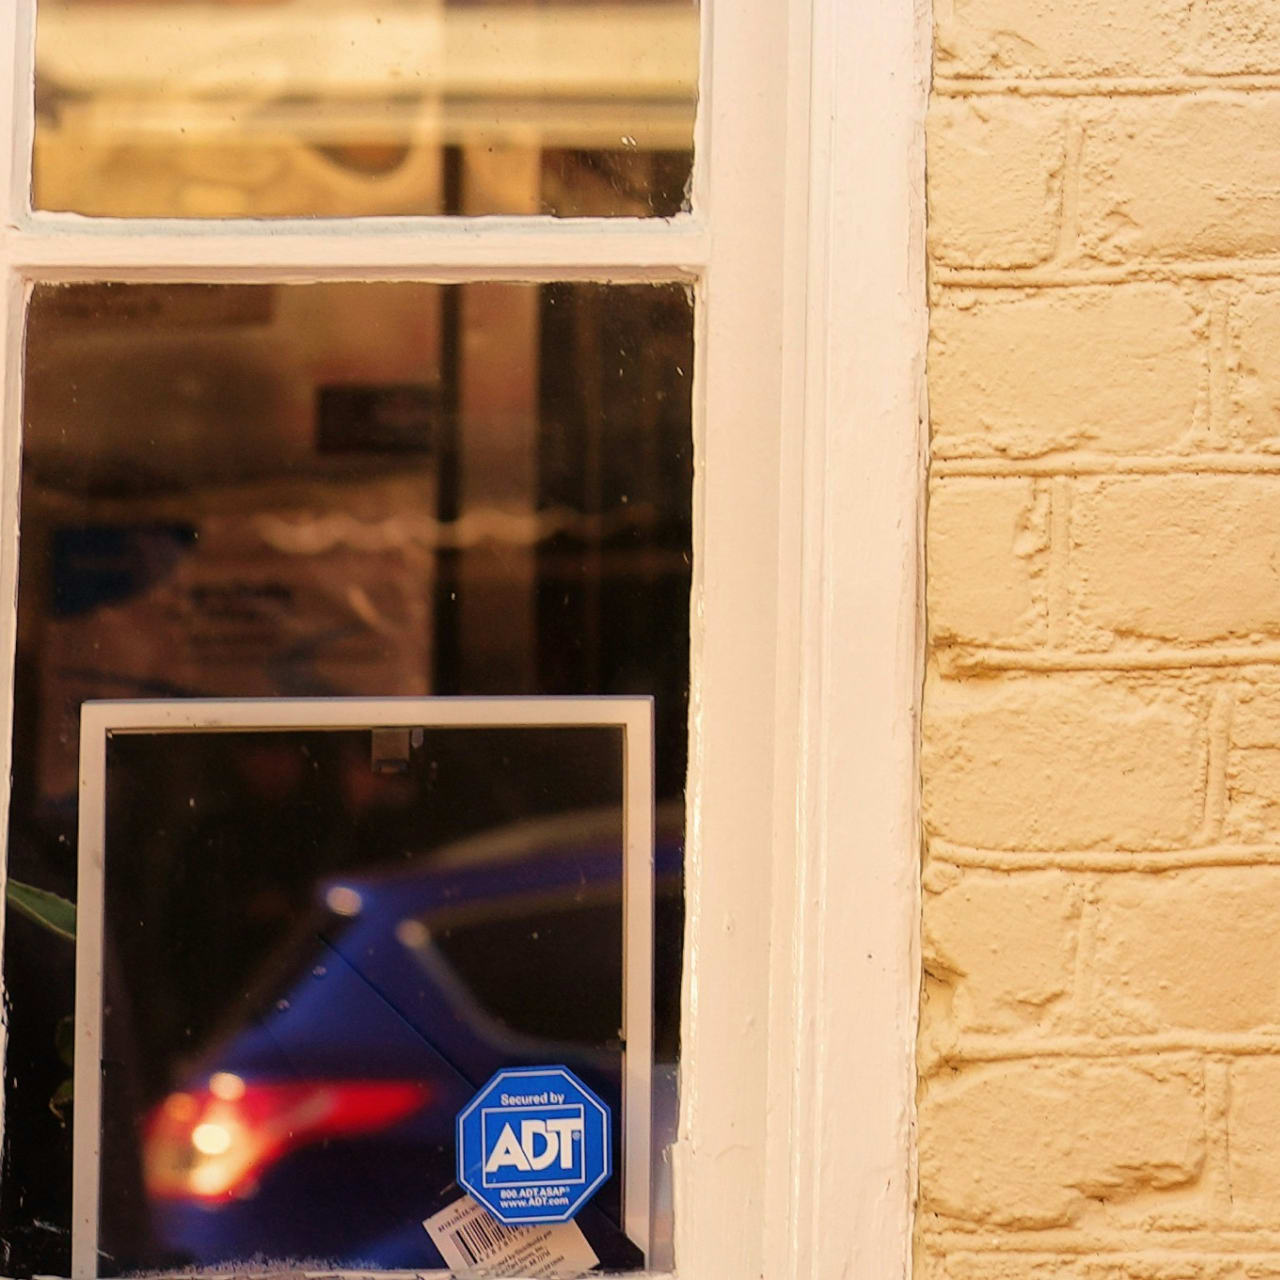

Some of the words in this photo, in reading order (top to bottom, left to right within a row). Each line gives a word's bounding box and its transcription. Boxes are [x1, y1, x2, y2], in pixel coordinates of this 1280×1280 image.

[501, 1092, 548, 1106] Secured
[550, 1091, 565, 1105] by
[485, 1118, 582, 1173] ADT
[500, 1197, 569, 1208] www.ADT.com
